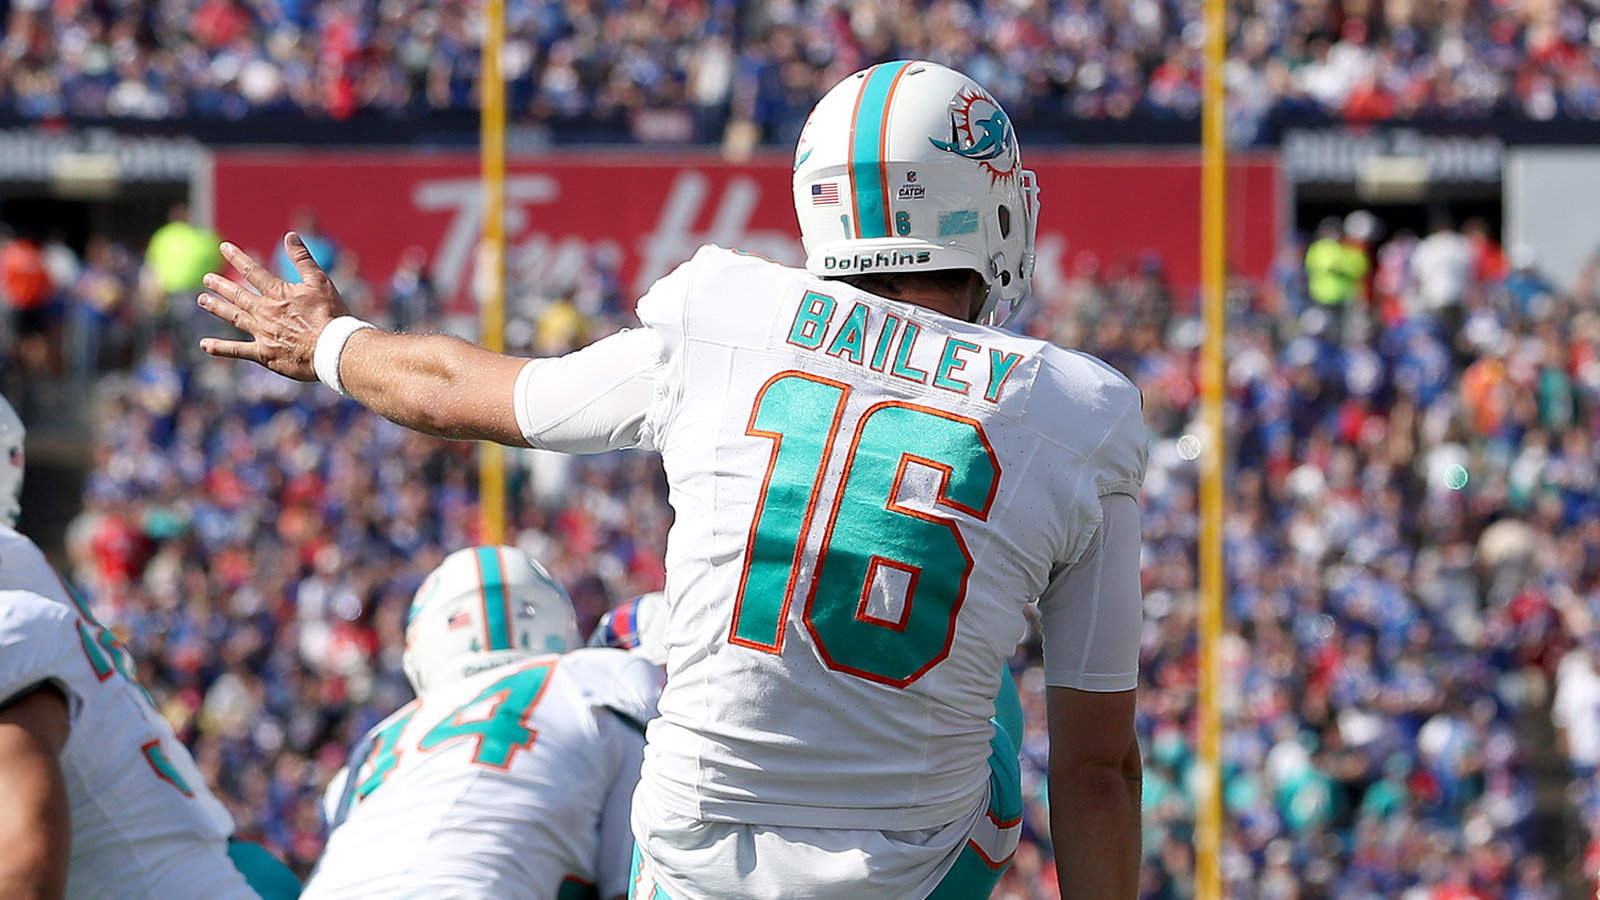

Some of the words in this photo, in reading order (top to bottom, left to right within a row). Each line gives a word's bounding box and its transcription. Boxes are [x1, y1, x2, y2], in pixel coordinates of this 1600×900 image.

[899, 187, 926, 196] CATCH
[895, 210, 912, 237] 6
[824, 250, 932, 272] Dolphins
[786, 289, 1024, 404] BAILEY
[729, 369, 1002, 689] 16
